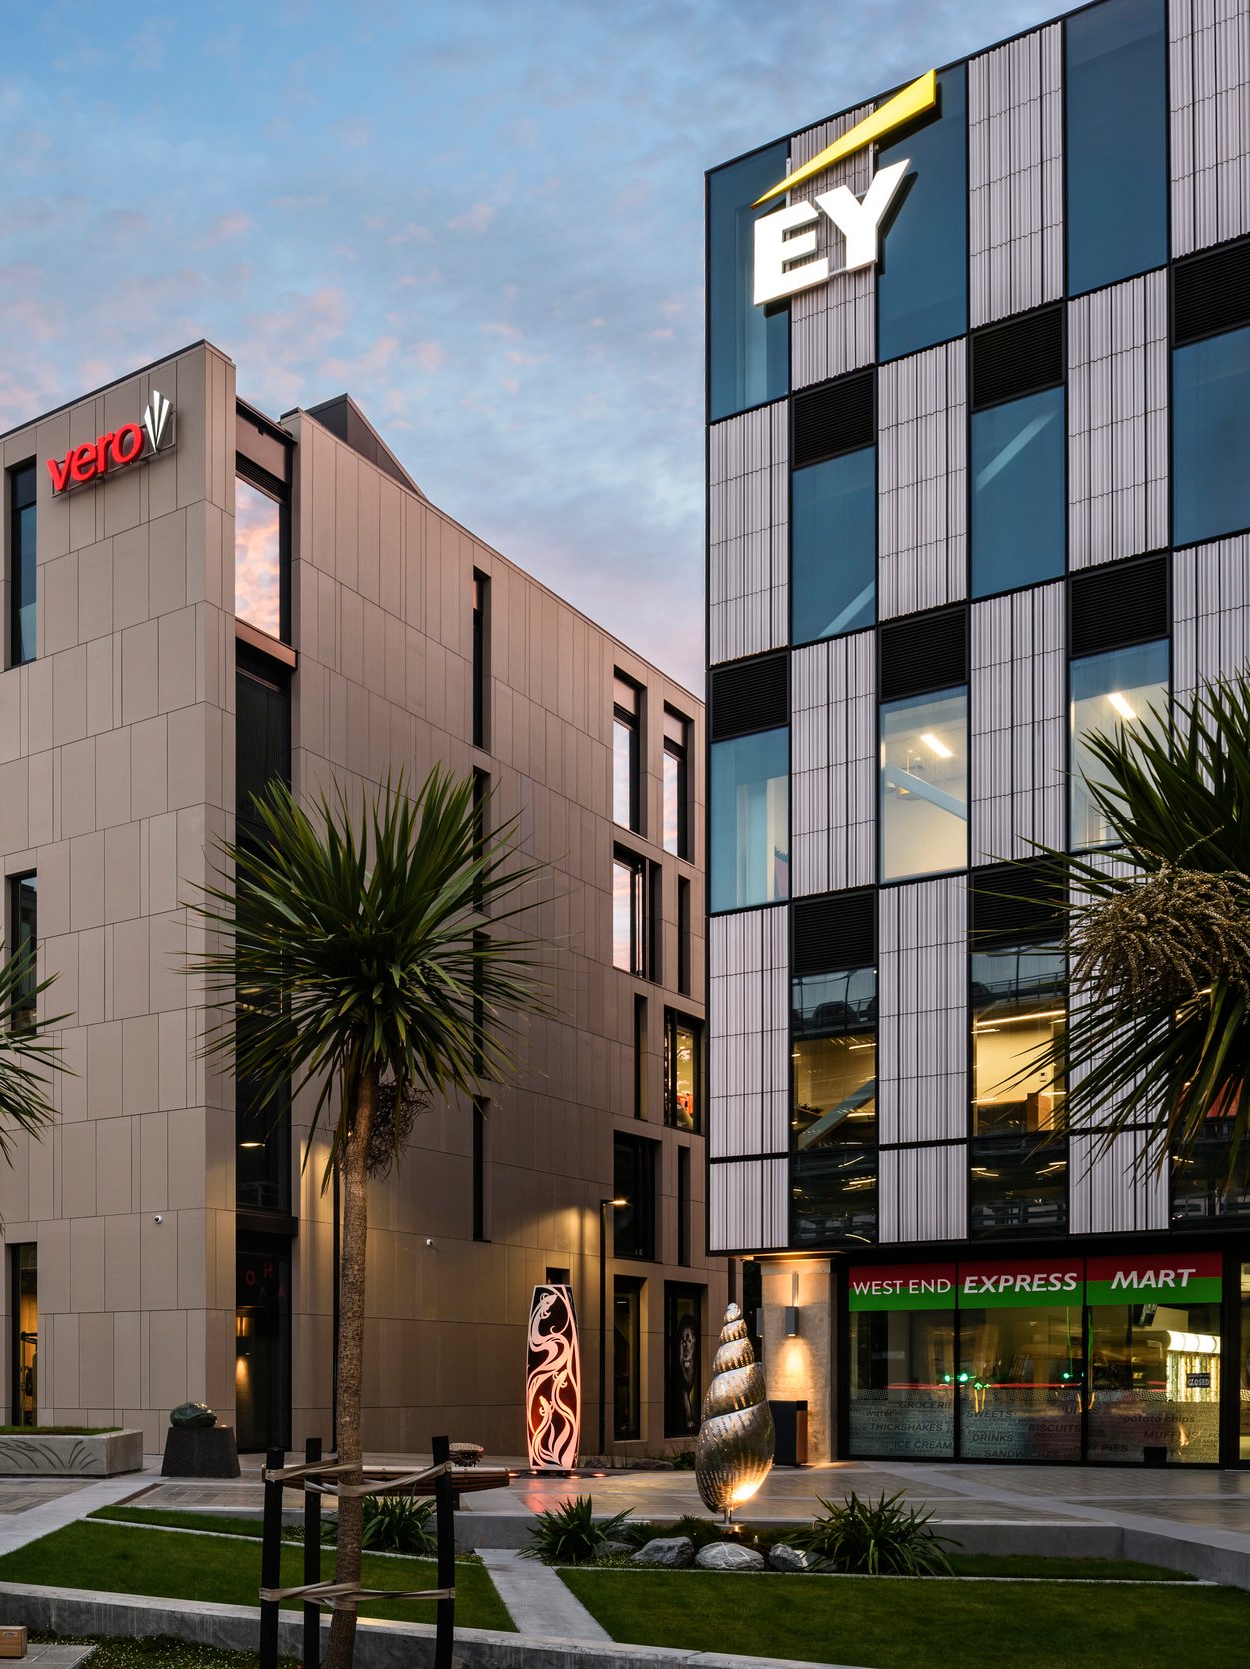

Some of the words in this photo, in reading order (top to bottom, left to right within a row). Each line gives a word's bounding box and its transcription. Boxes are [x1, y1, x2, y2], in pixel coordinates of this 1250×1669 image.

[753, 158, 910, 307] EY
[46, 423, 145, 492] vero
[853, 1280, 904, 1296] WEST
[909, 1279, 952, 1294] END
[963, 1272, 1078, 1294] EXPRESS
[1111, 1268, 1196, 1290] MART
[1187, 1378, 1209, 1386] CLOSED
[966, 1410, 1012, 1418] SWEETS
[1124, 1415, 1161, 1425] potato
[1165, 1414, 1195, 1424] chips
[870, 1423, 942, 1432] THICKSHAKES
[1028, 1423, 1081, 1433] BISCUITS
[972, 1433, 1014, 1442] DRINKS
[914, 1440, 952, 1449] CREAM
[984, 1449, 1059, 1458] SANDWICHES
